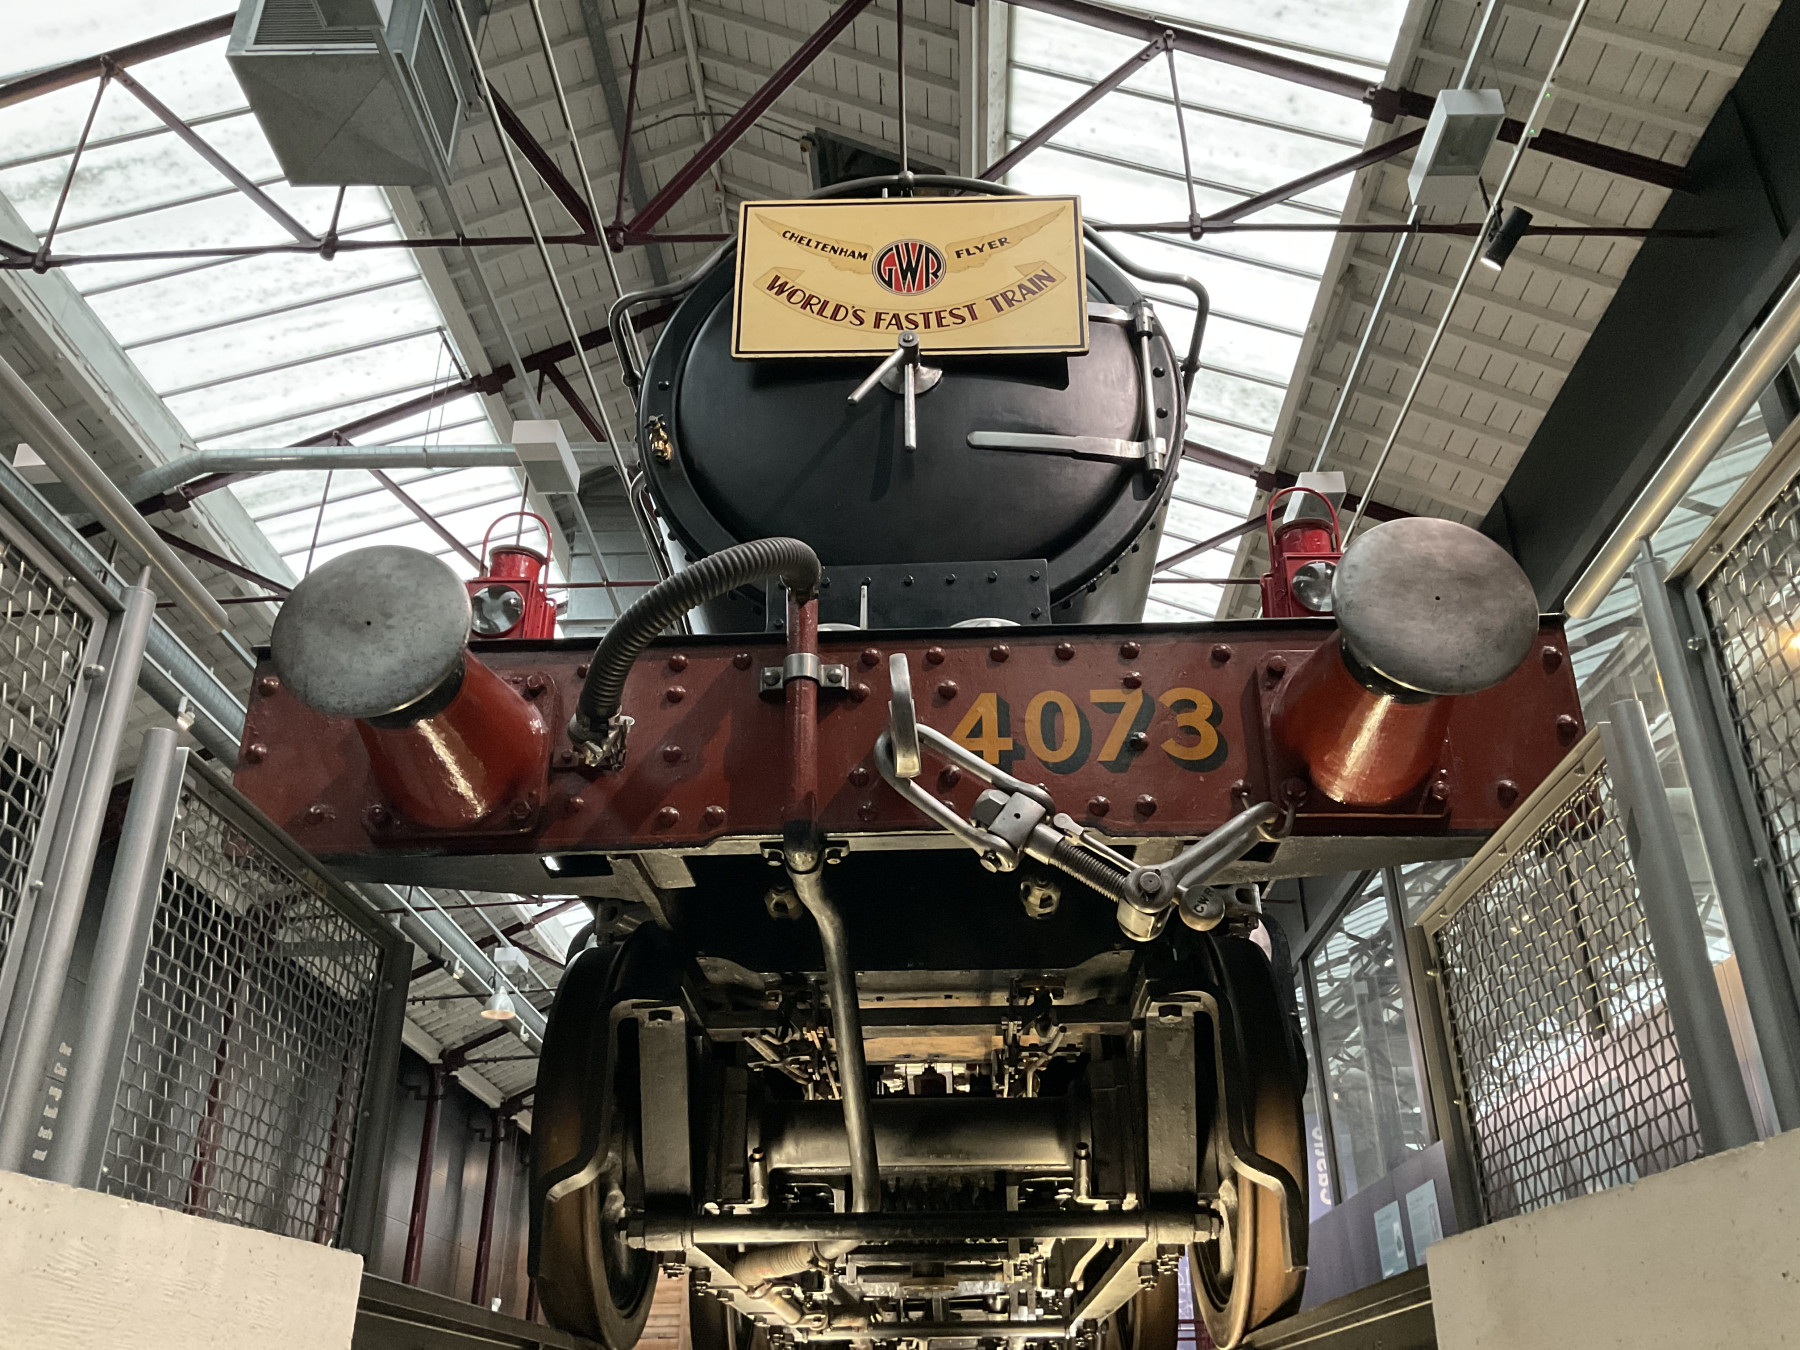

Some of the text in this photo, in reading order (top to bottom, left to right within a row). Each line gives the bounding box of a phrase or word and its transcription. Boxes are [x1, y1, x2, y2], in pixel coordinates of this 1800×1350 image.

[782, 230, 1011, 261] CHELTENHAM FLYER
[875, 242, 944, 294] GWR
[766, 268, 1057, 331] WORLD'S FASTEST TRAIN
[949, 687, 1219, 765] 4073
